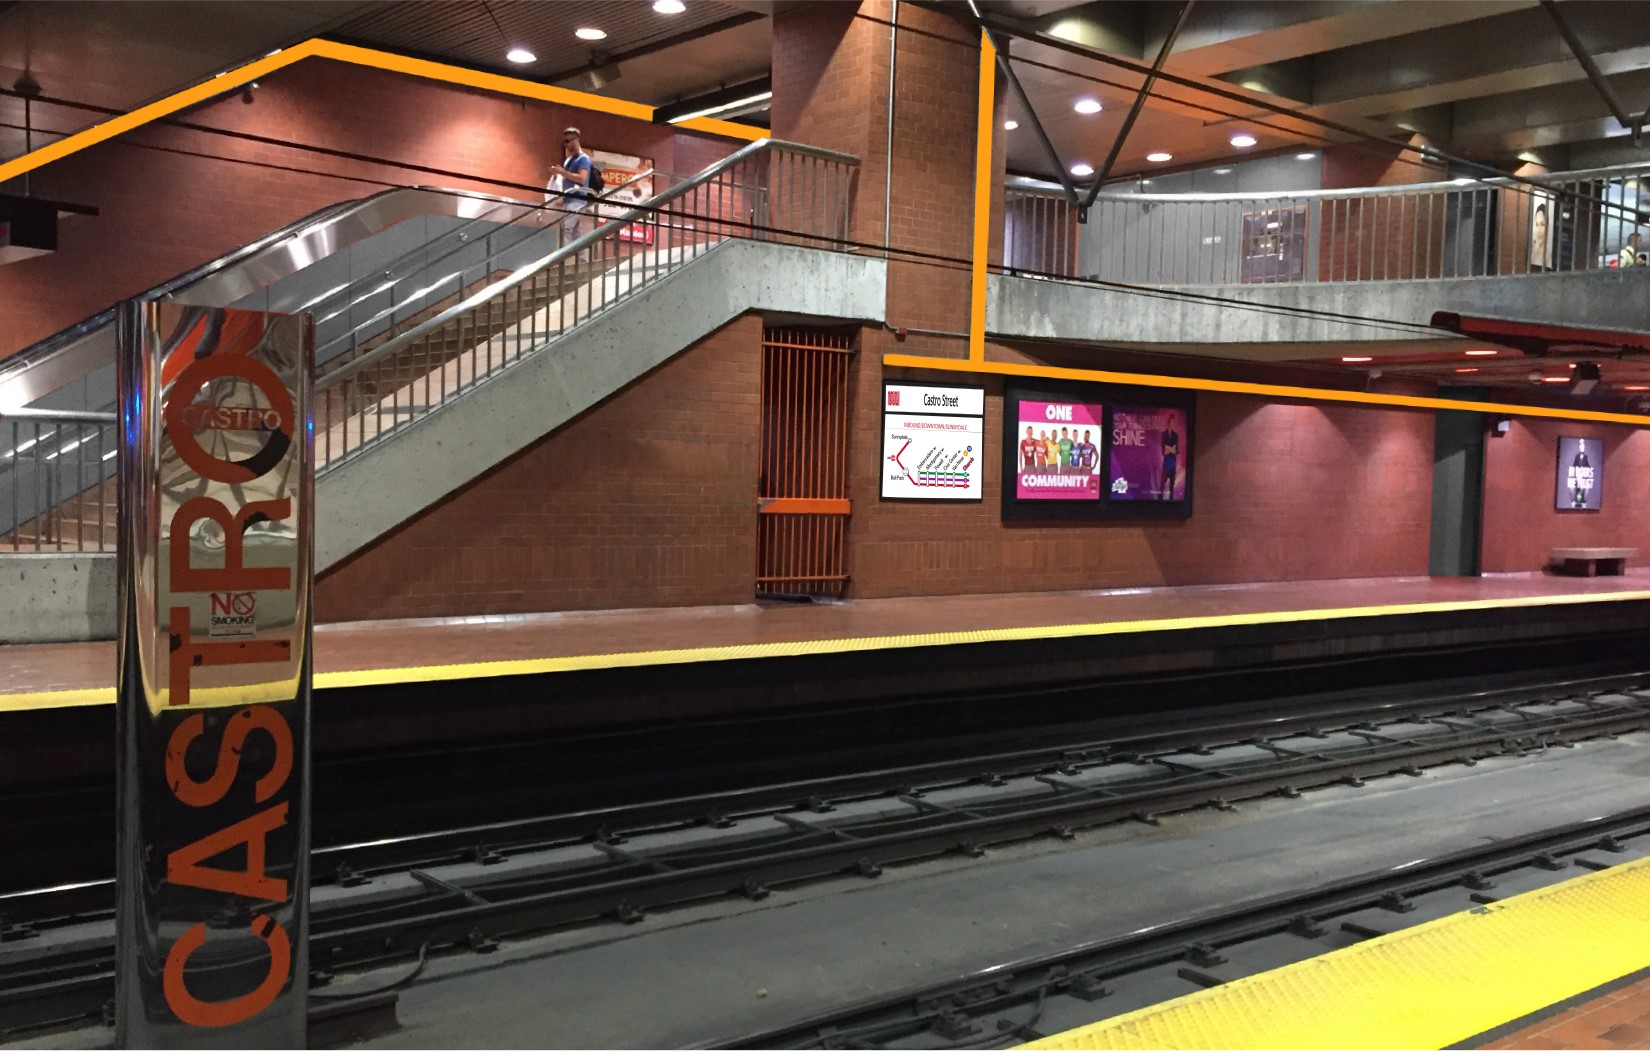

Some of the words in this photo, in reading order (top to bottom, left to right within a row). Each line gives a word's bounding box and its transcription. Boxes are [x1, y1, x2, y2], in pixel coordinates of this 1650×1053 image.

[923, 393, 942, 406] Castro
[942, 394, 959, 407] Street
[1045, 404, 1073, 421] ONE
[1112, 428, 1146, 447] SHINE
[1021, 474, 1090, 487] COMMUNITY
[211, 592, 255, 616] NO
[211, 616, 255, 625] SMOKING
[163, 353, 296, 1028] CASTRO
